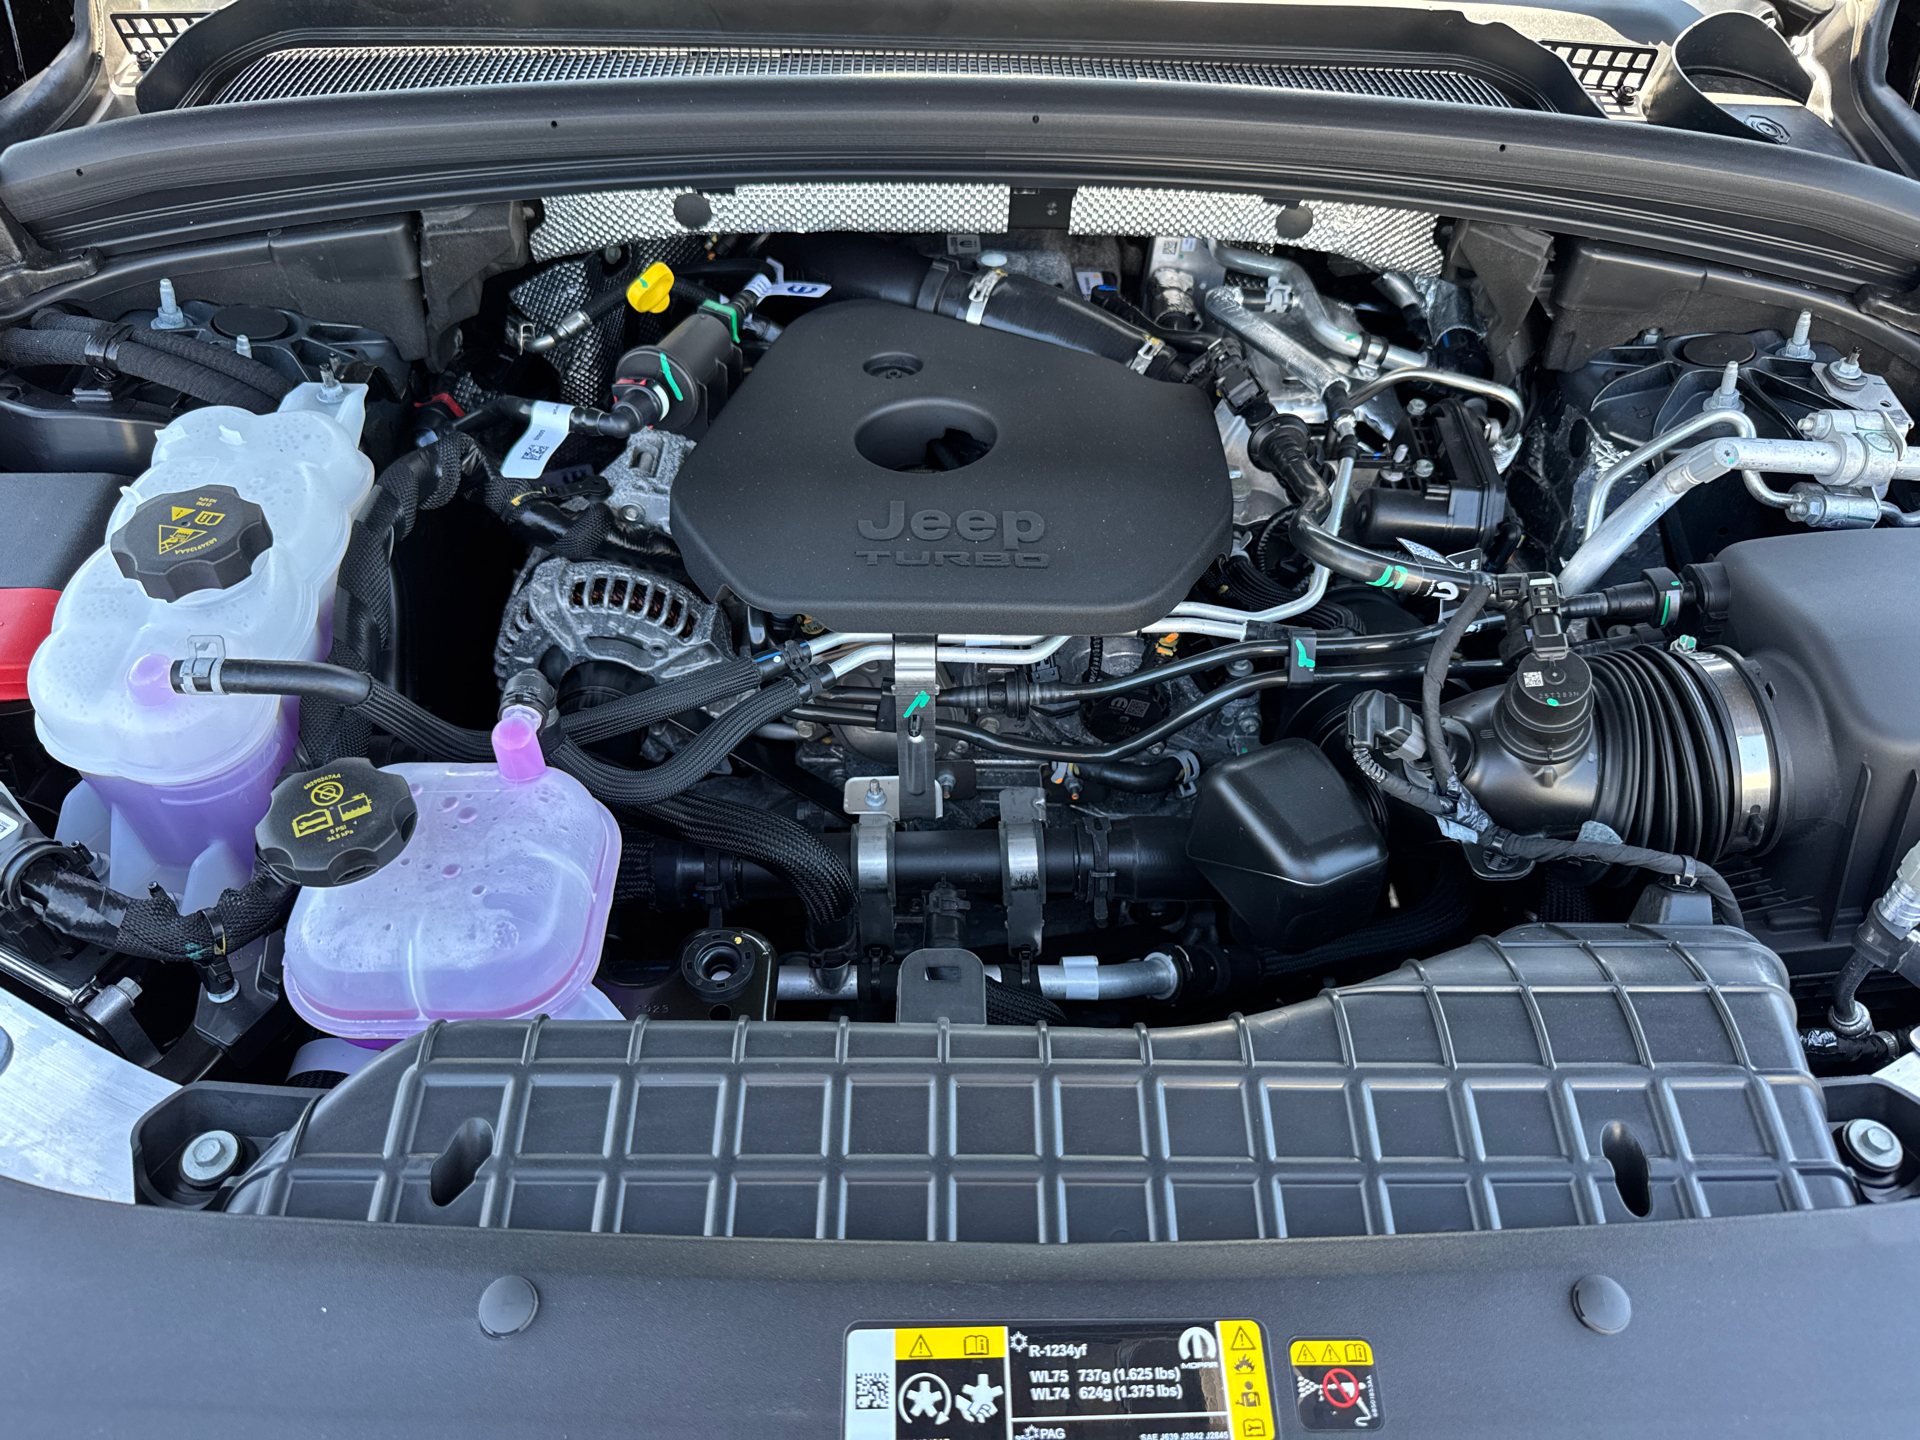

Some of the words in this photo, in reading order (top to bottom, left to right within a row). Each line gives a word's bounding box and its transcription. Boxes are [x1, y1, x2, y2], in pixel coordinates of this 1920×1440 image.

[857, 500, 1046, 551] Jeep
[854, 550, 1050, 568] TURBO
[335, 824, 347, 833] PSI
[1028, 1343, 1088, 1359] R-1234yf
[1180, 1361, 1219, 1370] MOPAR
[1029, 1370, 1070, 1383] WL75
[1077, 1368, 1111, 1384] 737g
[1113, 1367, 1153, 1384] (1.625
[1154, 1366, 1182, 1382] lbs)
[1030, 1387, 1071, 1401] WL74
[1078, 1385, 1112, 1402] 624g
[1114, 1384, 1155, 1402] (1.375
[1156, 1383, 1183, 1400] lbs)
[1040, 1428, 1066, 1440] PAG
[1159, 1432, 1179, 1440] J639
[1180, 1431, 1204, 1440] J2842
[1205, 1431, 1229, 1440] J2845
